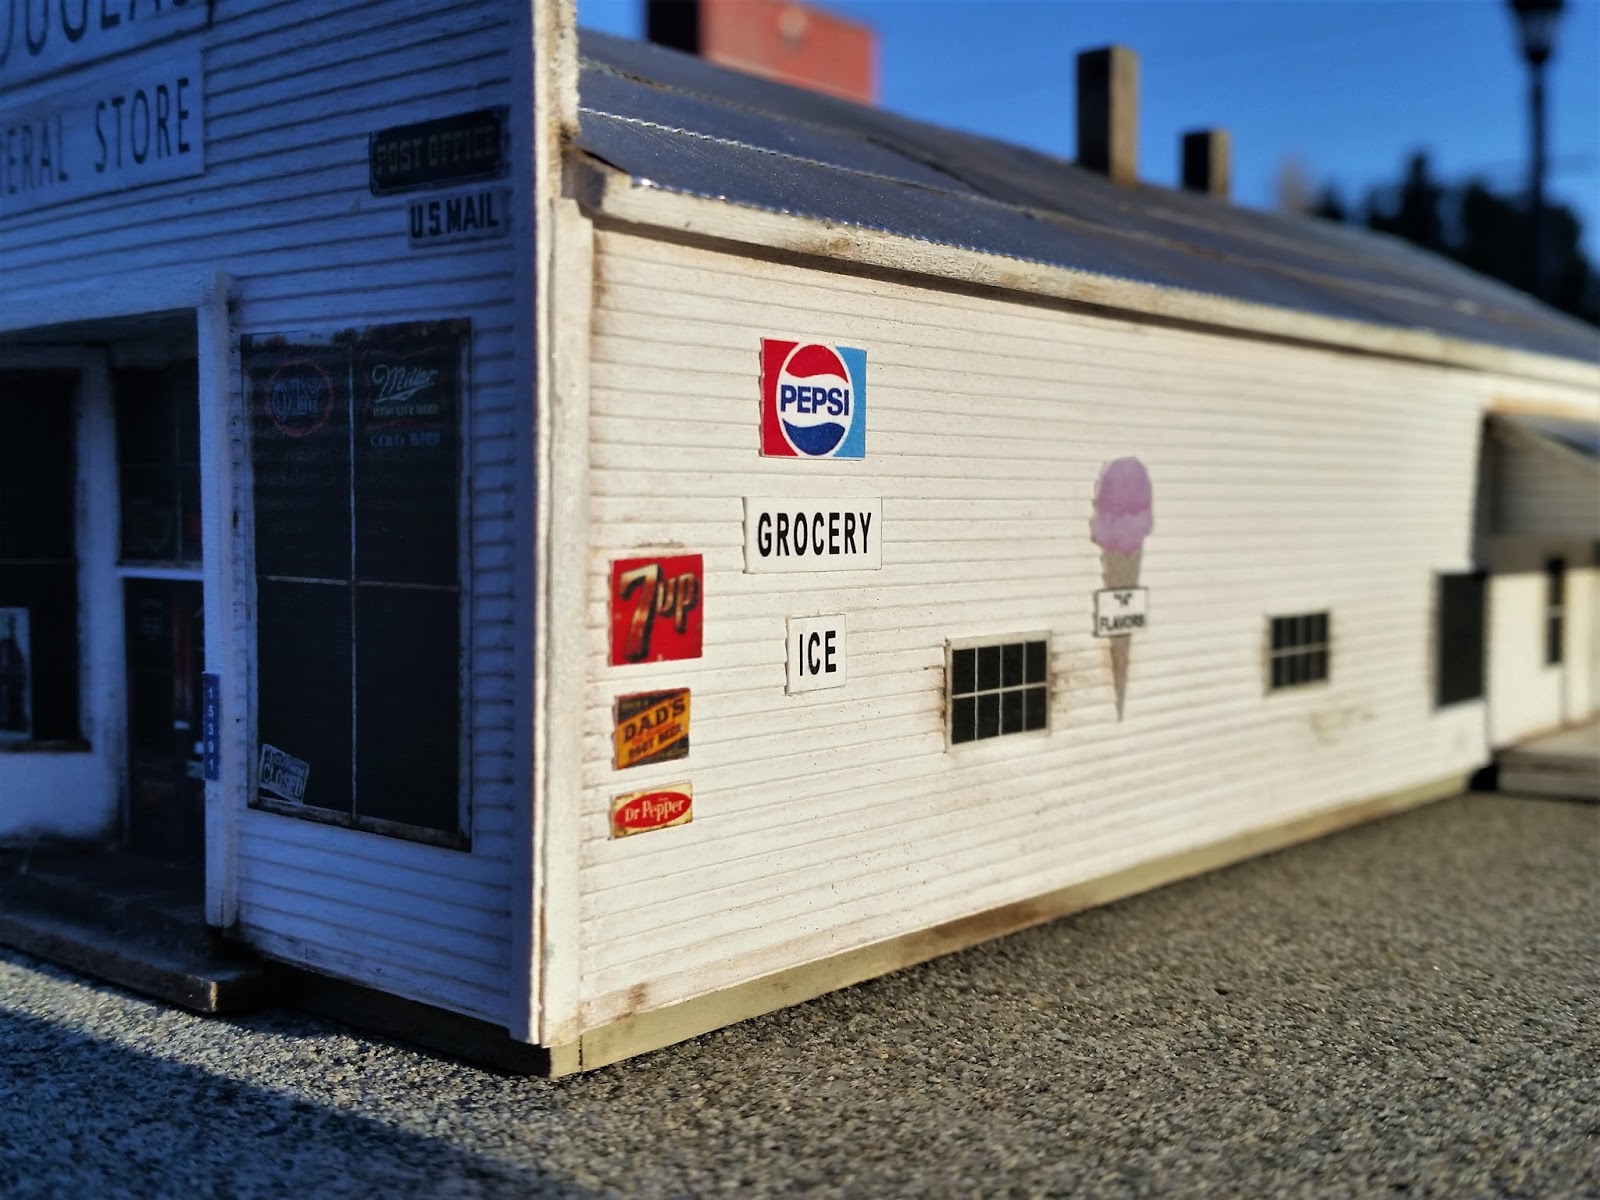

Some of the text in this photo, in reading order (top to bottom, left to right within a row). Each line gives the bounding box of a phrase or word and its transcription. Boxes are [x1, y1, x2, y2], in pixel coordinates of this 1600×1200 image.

[0, 77, 190, 195] ERAL STORE
[372, 363, 439, 401] Miller
[780, 384, 849, 416] PEPSI
[757, 512, 872, 557] GROCERY
[1099, 613, 1145, 632] FLAVORS
[799, 630, 837, 676] ICE
[624, 800, 685, 822] Dr Pepper
